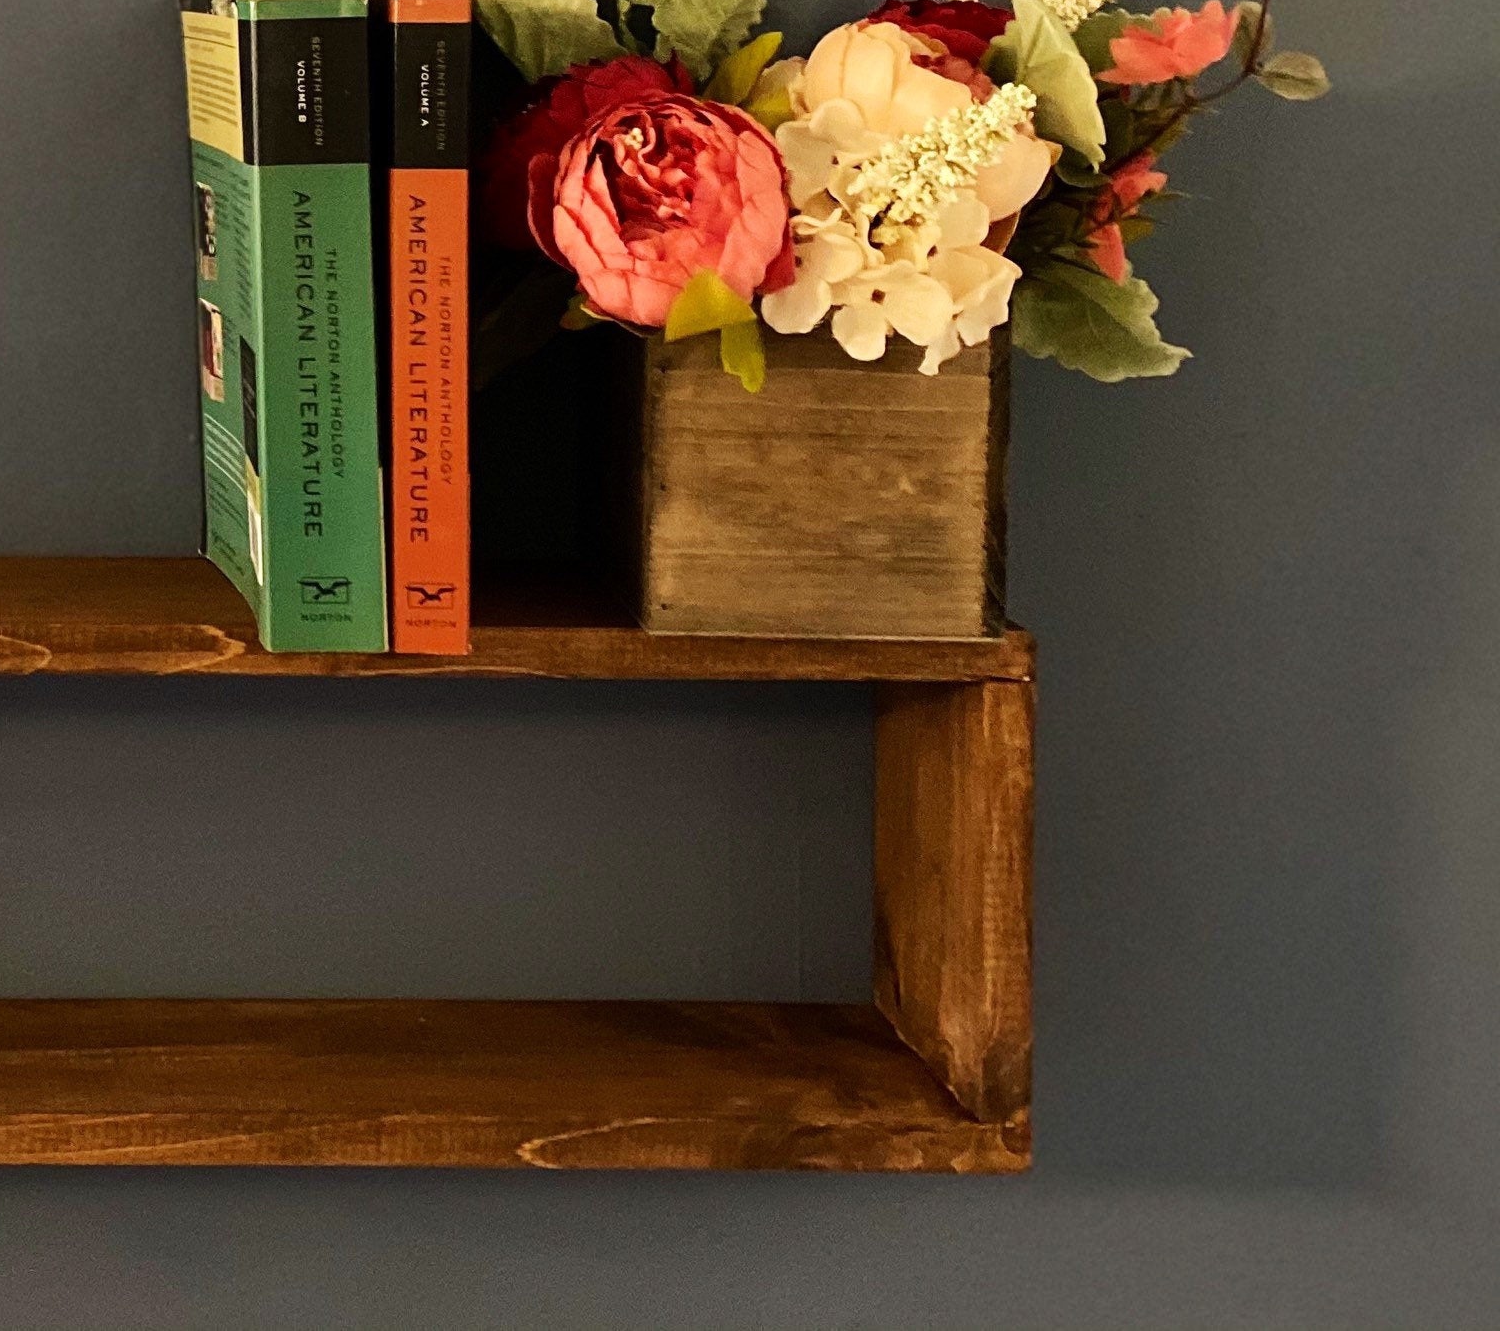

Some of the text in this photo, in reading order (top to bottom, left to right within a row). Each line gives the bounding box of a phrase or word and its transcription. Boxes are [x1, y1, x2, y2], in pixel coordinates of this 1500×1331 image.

[297, 60, 307, 123] VOLUME B
[311, 36, 324, 146] SEVENTH EDITION
[420, 64, 430, 127] VOLUME A
[436, 40, 447, 97] SEVENTH
[293, 190, 323, 537] AMERICAN LITERATURE
[325, 248, 344, 479] THE NORTON ANTHOLOGY
[409, 194, 429, 543] AMERICAN LITERATURE
[439, 256, 453, 485] THE NORTON ANTHOLOGY
